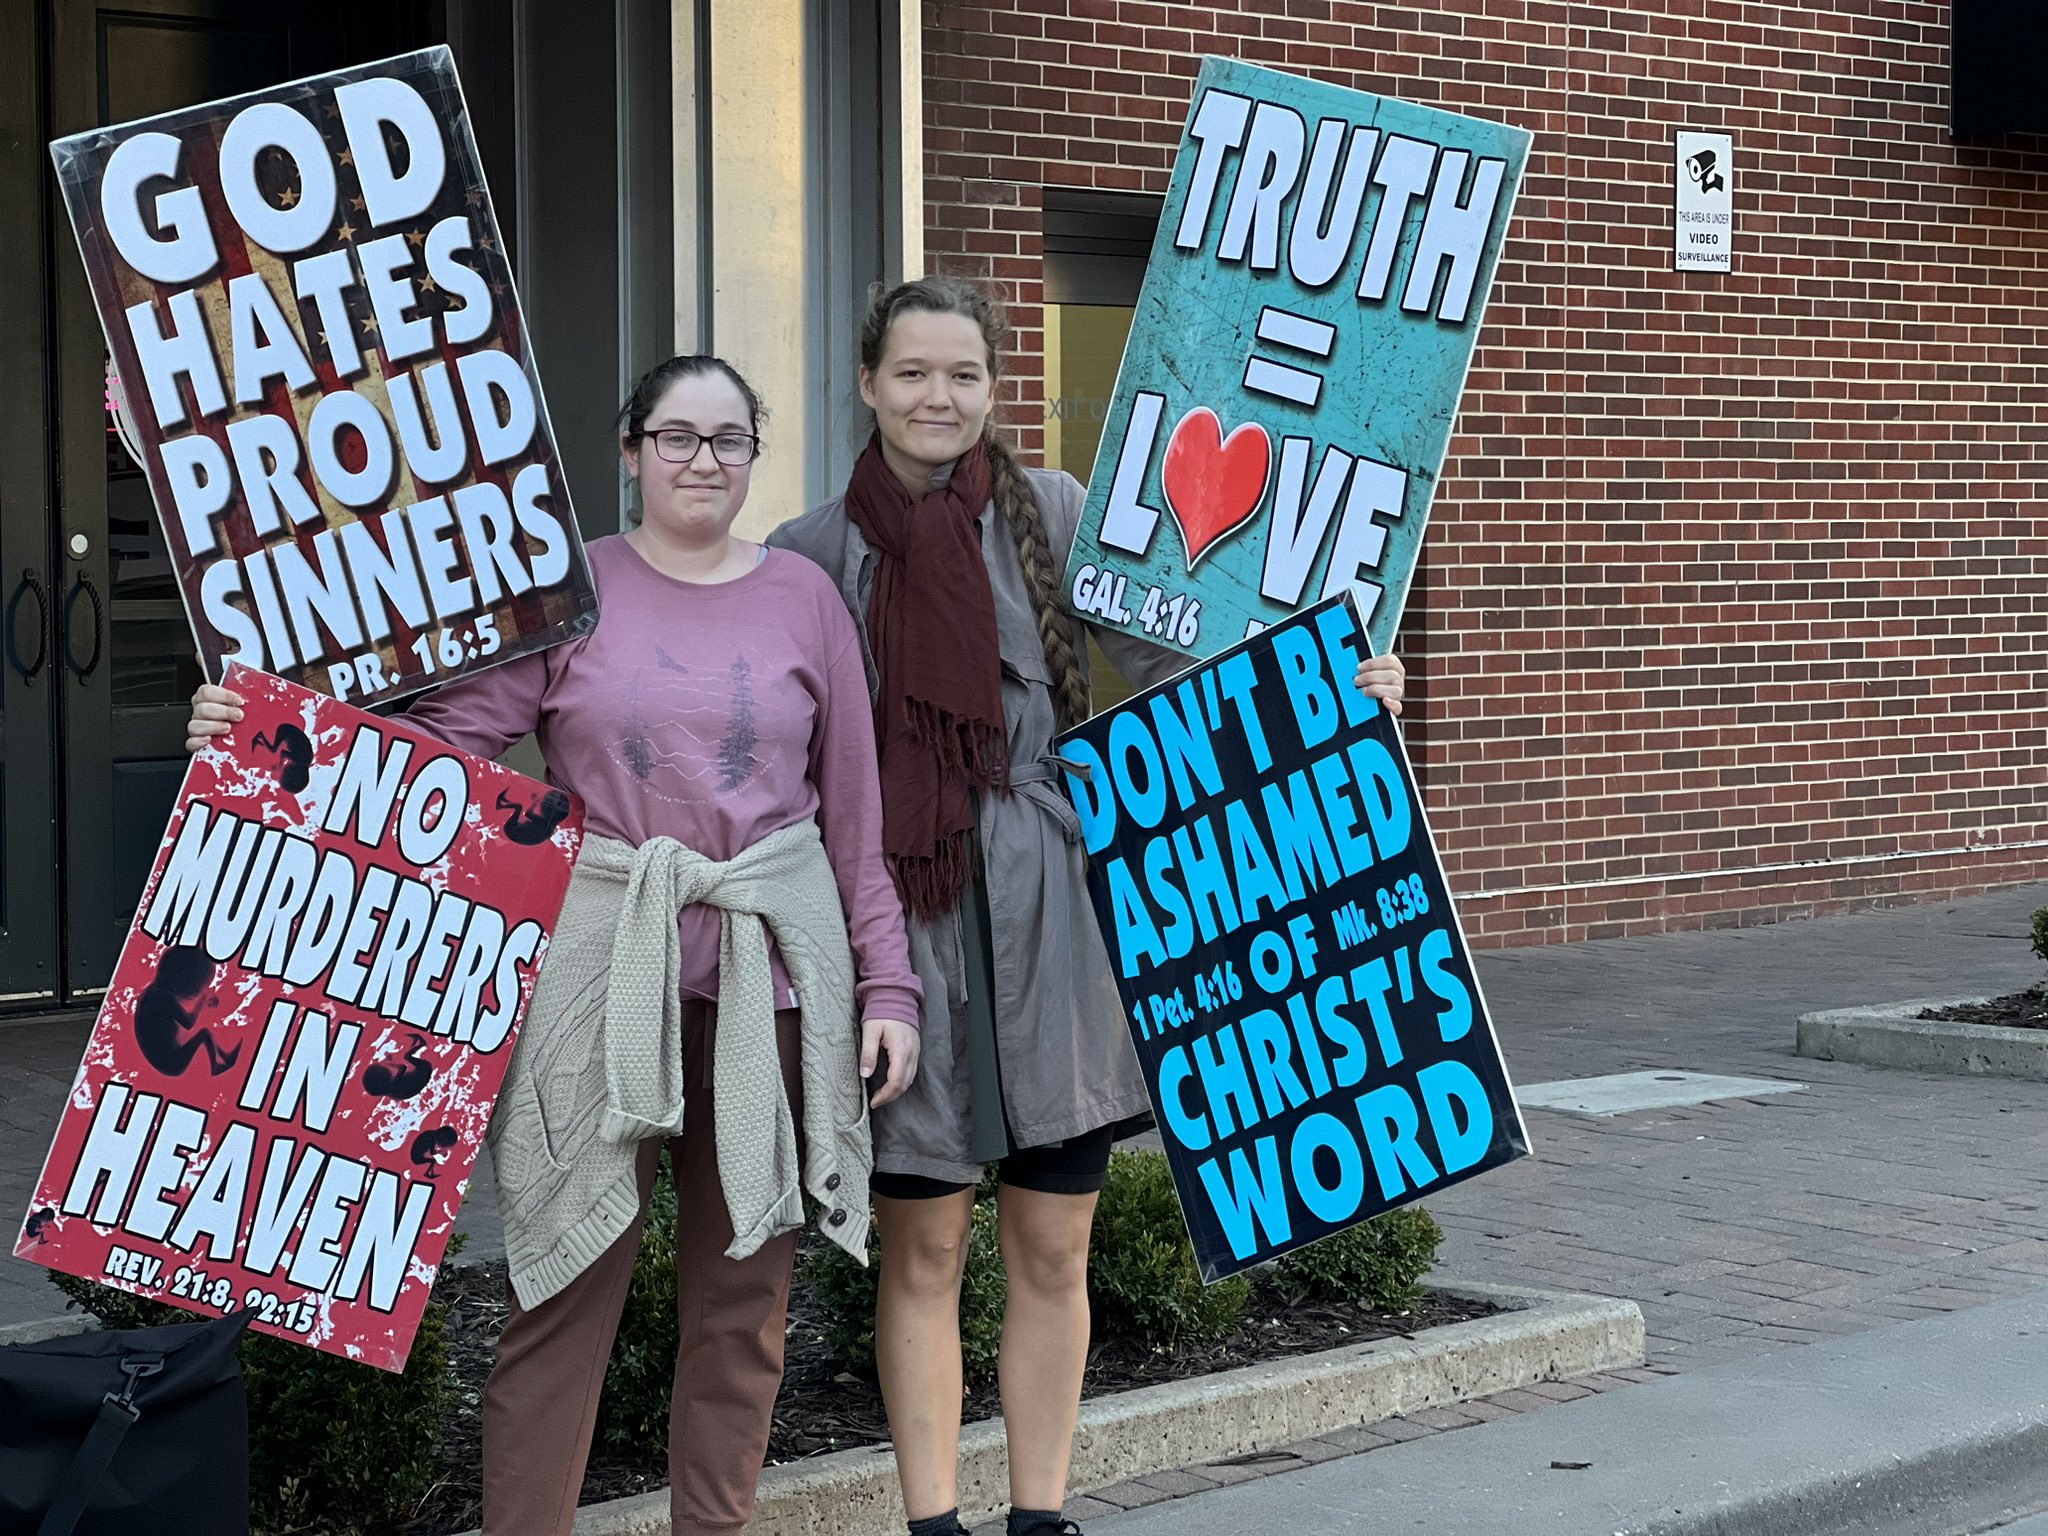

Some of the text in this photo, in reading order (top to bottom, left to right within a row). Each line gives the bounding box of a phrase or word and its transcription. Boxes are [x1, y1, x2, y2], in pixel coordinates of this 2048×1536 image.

[101, 77, 446, 283] GOD
[1175, 88, 1508, 324] TRUTH
[1678, 252, 1729, 263] SURVEILLANCE
[1679, 211, 1690, 223] THIS
[1691, 212, 1705, 224] AREA
[1712, 213, 1729, 225] UNDER
[1689, 233, 1718, 245] VIDEO
[125, 216, 493, 429] HATES
[159, 350, 536, 557] PROUD
[201, 464, 569, 674] SINNERS
[327, 613, 501, 702] PR. 16:5
[1072, 564, 1203, 647] GAL. 4:16
[325, 724, 469, 867] NO
[1058, 603, 1378, 855] DON'T BE
[144, 801, 545, 1053] MURDERERS
[1107, 737, 1412, 979] ASHAMED
[1133, 873, 1429, 1041] 1 Pet. 4:16 OF Mk. 8:38
[240, 999, 359, 1134] IN
[1158, 929, 1472, 1151] CHRIST'S
[62, 1084, 432, 1314] HEAVEN
[1196, 1060, 1493, 1261] WORD
[104, 1246, 315, 1334] REV. 21:8, 22:15
